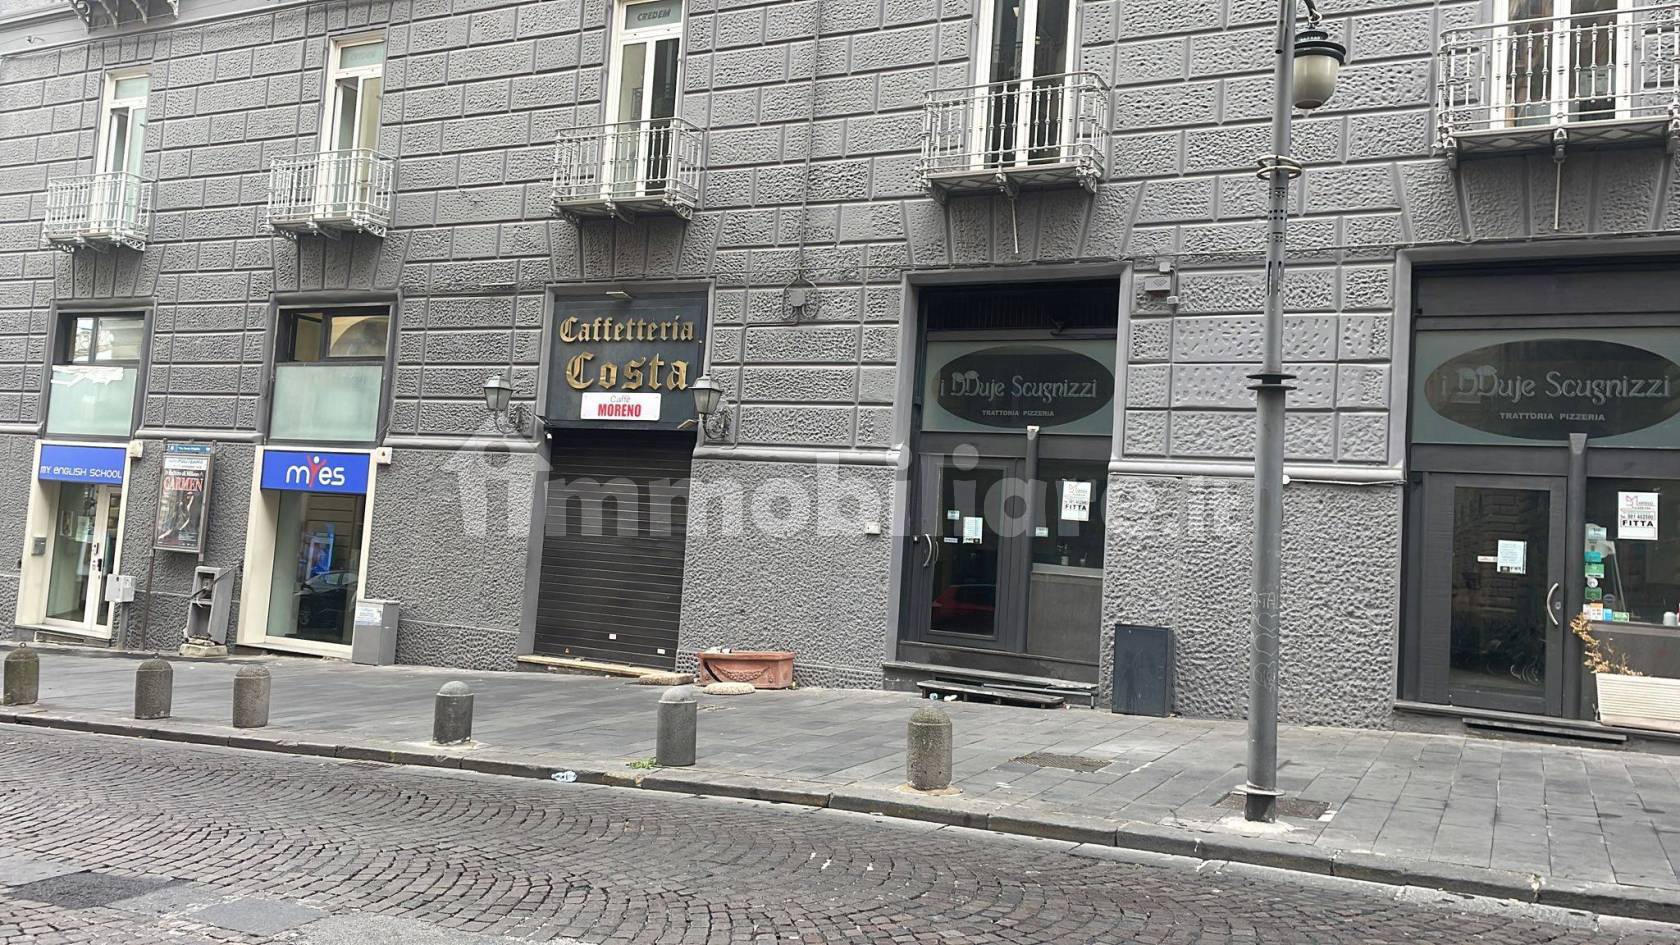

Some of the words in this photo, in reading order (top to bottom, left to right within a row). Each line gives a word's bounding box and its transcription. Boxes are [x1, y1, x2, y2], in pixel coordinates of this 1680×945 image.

[637, 7, 672, 21] CREDEM
[559, 315, 694, 342] Caffetteria
[566, 351, 689, 391] Costa
[1011, 375, 1097, 403] Scugnizzi
[1545, 370, 1671, 405] Scugnizzi
[597, 403, 642, 417] MORENO
[982, 409, 1020, 417] TRATTORIA
[1499, 412, 1554, 420] TRATTORIA
[1559, 413, 1606, 422] PIZZERIA
[89, 468, 122, 479] SCHOOL
[163, 476, 203, 492] CARMEN
[1064, 504, 1087, 512] FITTA
